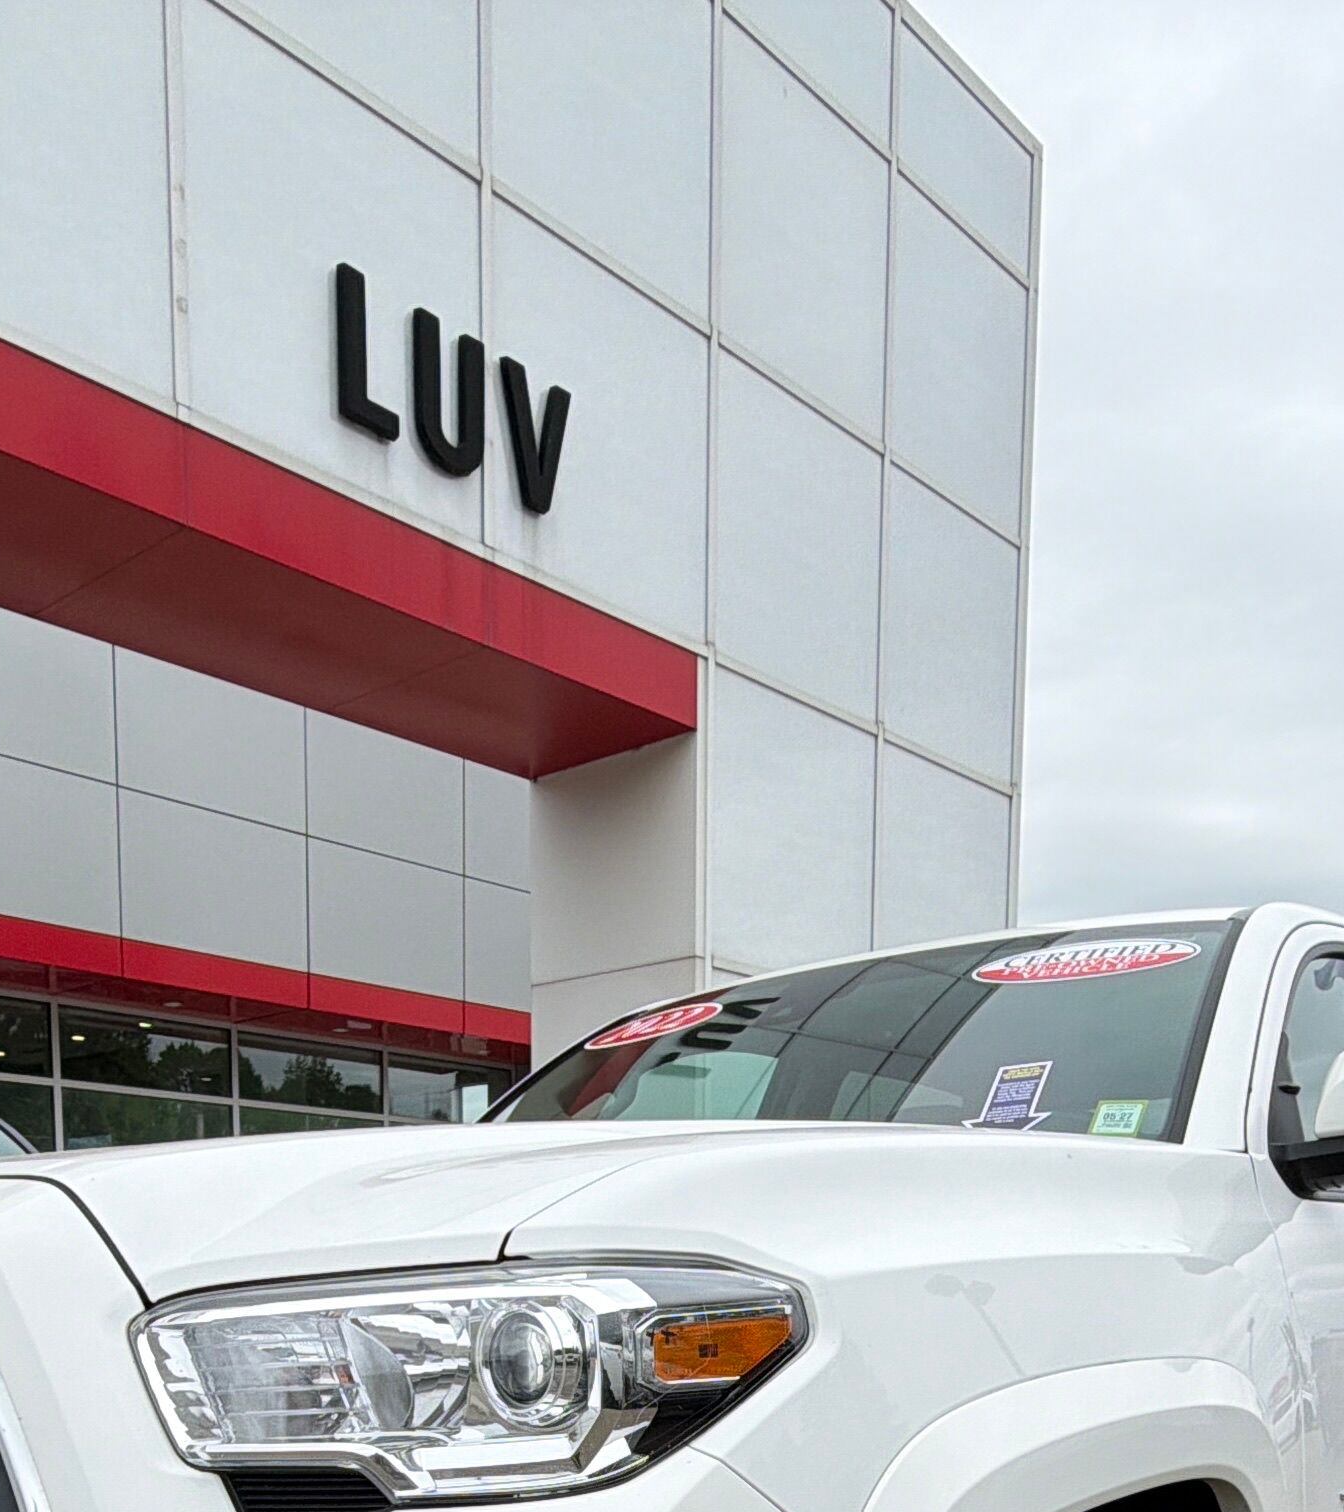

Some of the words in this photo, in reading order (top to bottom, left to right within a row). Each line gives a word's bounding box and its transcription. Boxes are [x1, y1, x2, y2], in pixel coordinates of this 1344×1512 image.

[336, 262, 572, 515] LUV
[1004, 943, 1177, 968] CERTIFIED
[1023, 962, 1132, 979] VEHICLE
